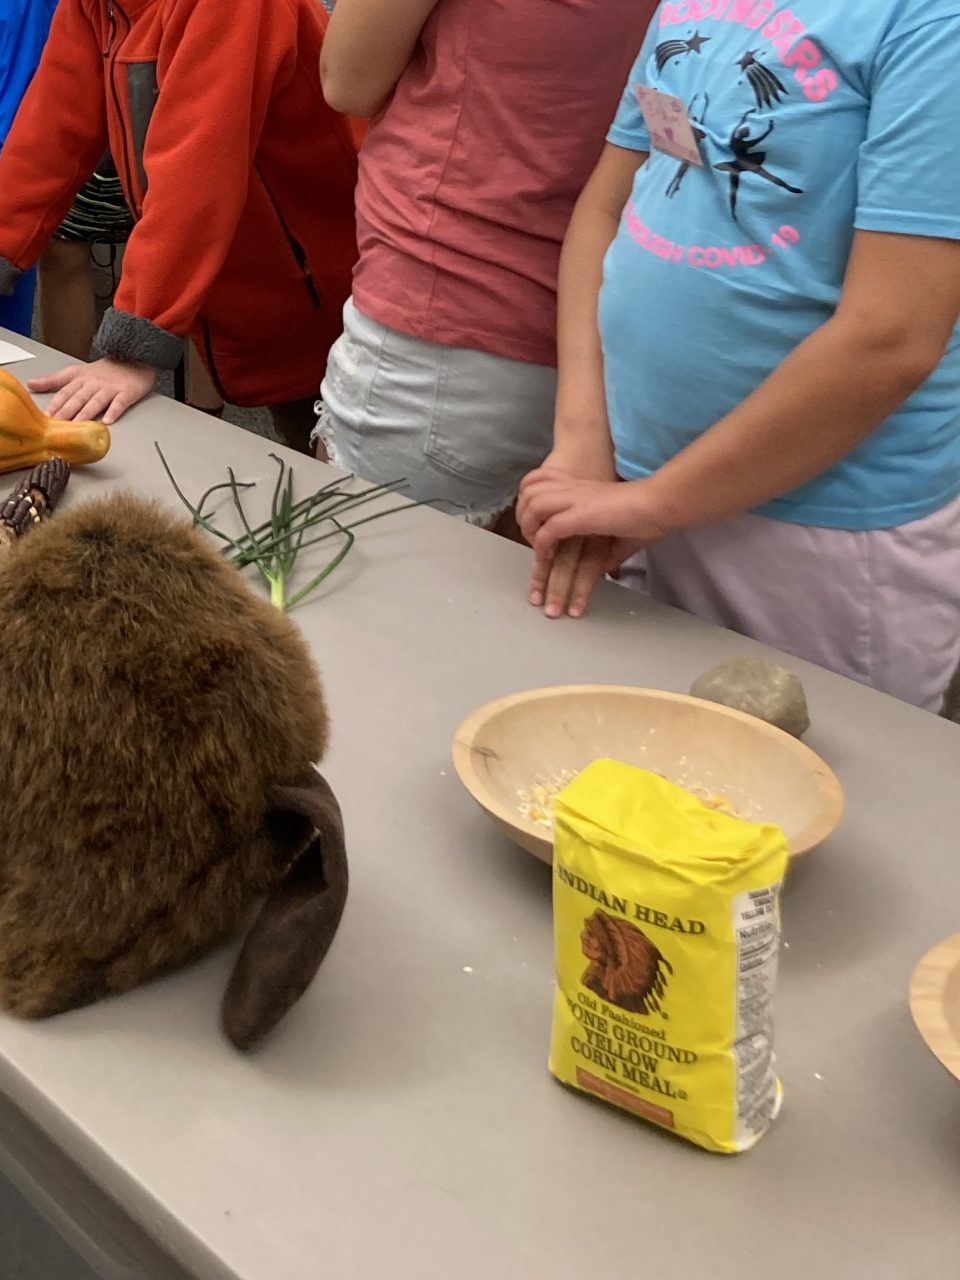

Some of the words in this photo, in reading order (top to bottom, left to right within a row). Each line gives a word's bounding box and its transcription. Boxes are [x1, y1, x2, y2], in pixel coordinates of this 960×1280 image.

[558, 863, 629, 914] INDIAN
[634, 902, 706, 935] HEAD
[577, 992, 598, 1011] Old
[601, 1005, 666, 1041] Fashioned
[570, 1035, 617, 1074] CORN
[621, 1061, 677, 1099] MEAL
[583, 1024, 659, 1074] YELLOW
[612, 1024, 699, 1064] GROUND
